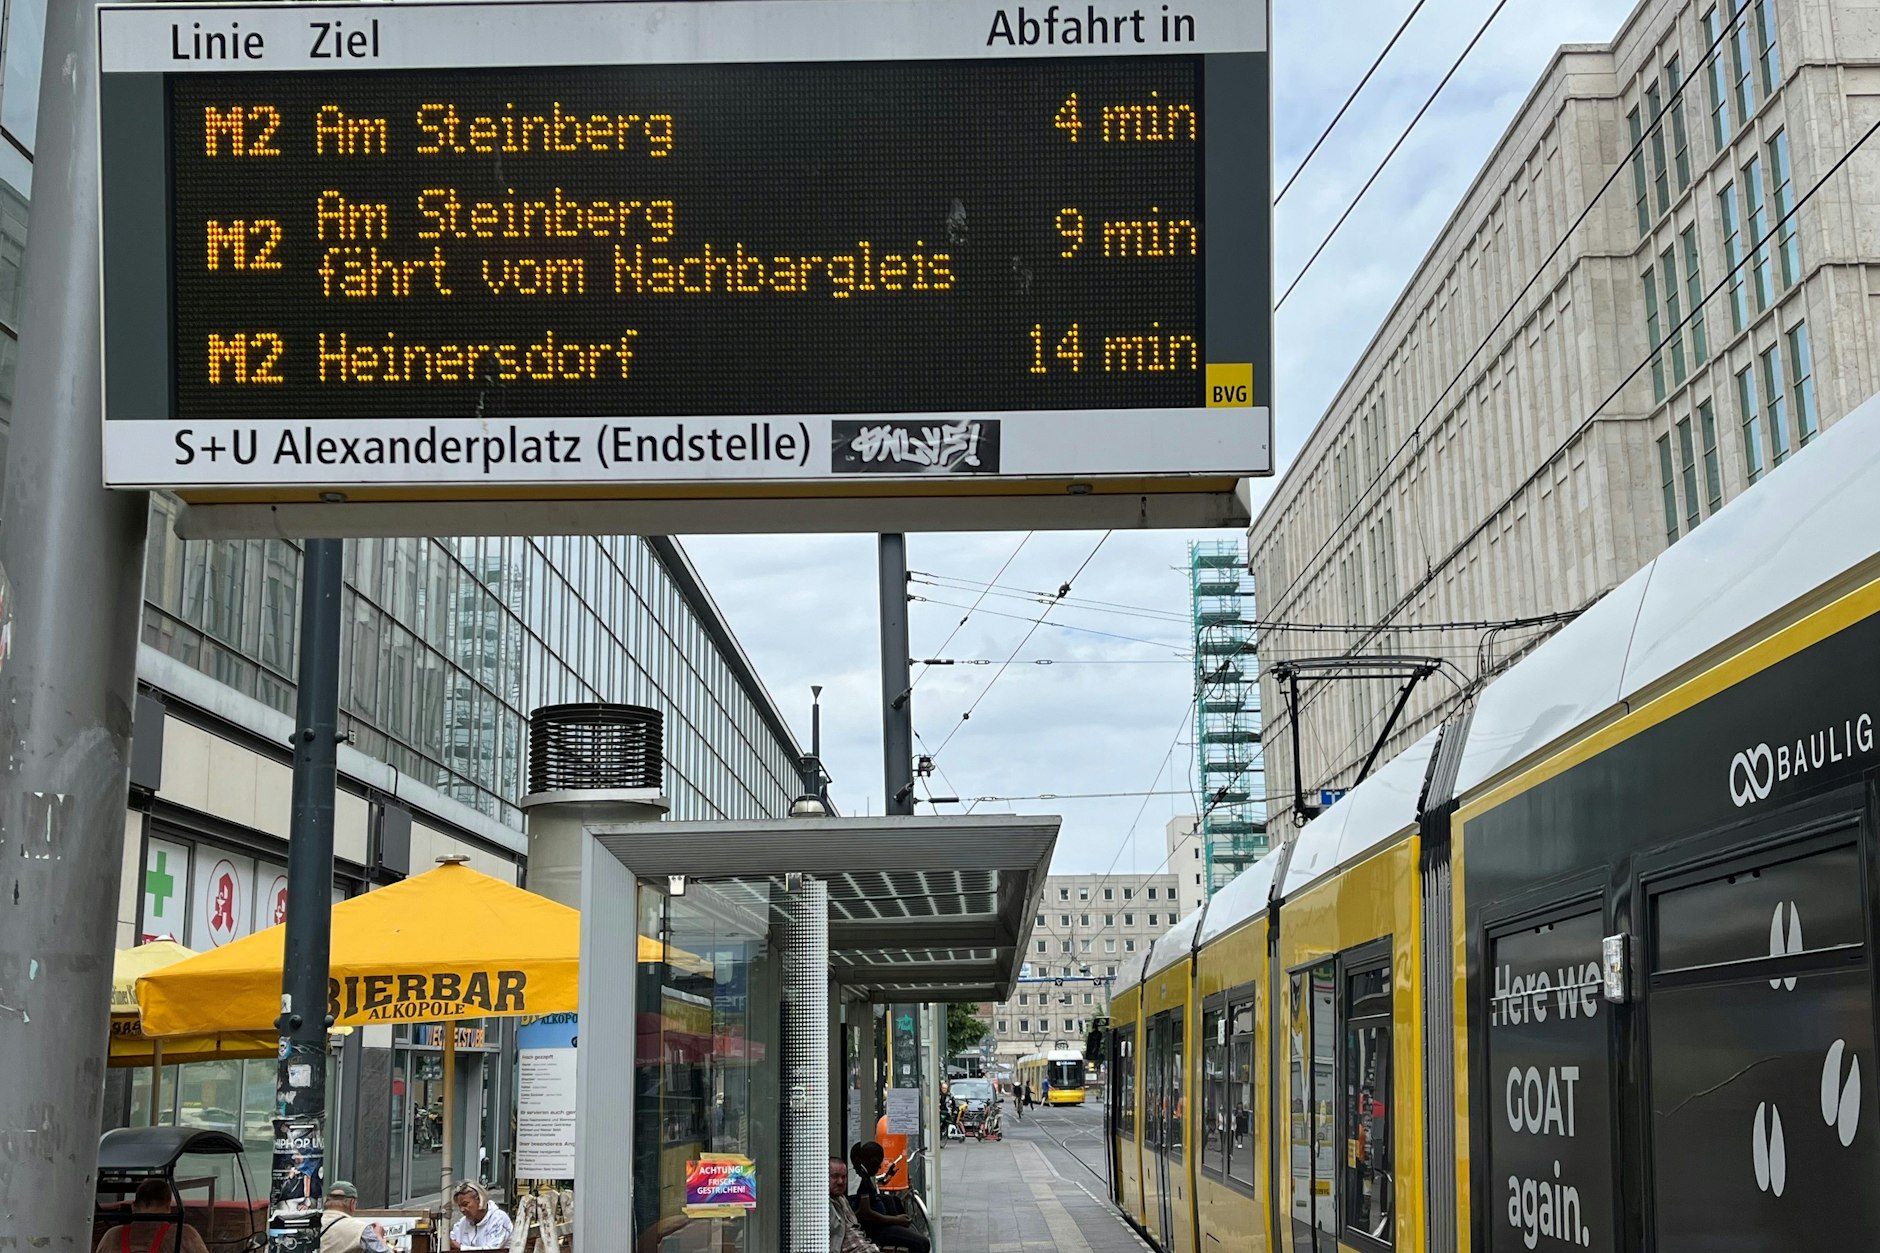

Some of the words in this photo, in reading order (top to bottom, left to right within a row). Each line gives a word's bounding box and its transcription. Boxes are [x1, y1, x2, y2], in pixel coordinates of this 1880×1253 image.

[172, 22, 264, 60] Linie
[309, 18, 379, 59] Ziel
[986, 5, 1145, 47] Abfahrt
[1161, 4, 1195, 43] in
[205, 105, 281, 157] M2
[316, 105, 387, 155] Am
[416, 102, 673, 157] Steinberg
[1055, 92, 1082, 142] 4
[1103, 91, 1196, 142] min
[206, 219, 283, 271] M2
[1055, 207, 1083, 258] 9
[1103, 207, 1196, 257] min
[317, 190, 388, 240] Am
[417, 187, 674, 243] Steinberg
[319, 246, 452, 297] fährt
[482, 258, 584, 295] vom
[614, 241, 955, 299] Nachbargleis
[208, 332, 284, 384] M2
[318, 330, 638, 382] Heinersdorf
[1030, 323, 1084, 374] 14
[1104, 321, 1197, 372] min
[1213, 385, 1247, 403] BVG
[174, 429, 257, 465] S+U
[273, 425, 581, 474] Alexanderplatz
[598, 422, 811, 469] (Endstelle)
[1777, 713, 1873, 782] BAULIG
[368, 1001, 465, 1020] ALKOPOLE
[1492, 964, 1551, 1027] Here
[1557, 961, 1602, 1020] we
[1506, 1066, 1580, 1137] GOAT
[697, 1185, 746, 1195] GESTRICHEN!
[699, 1165, 744, 1175] ACHTUNG!
[708, 1178, 736, 1186] FRISCH
[1508, 1160, 1590, 1250] again.
